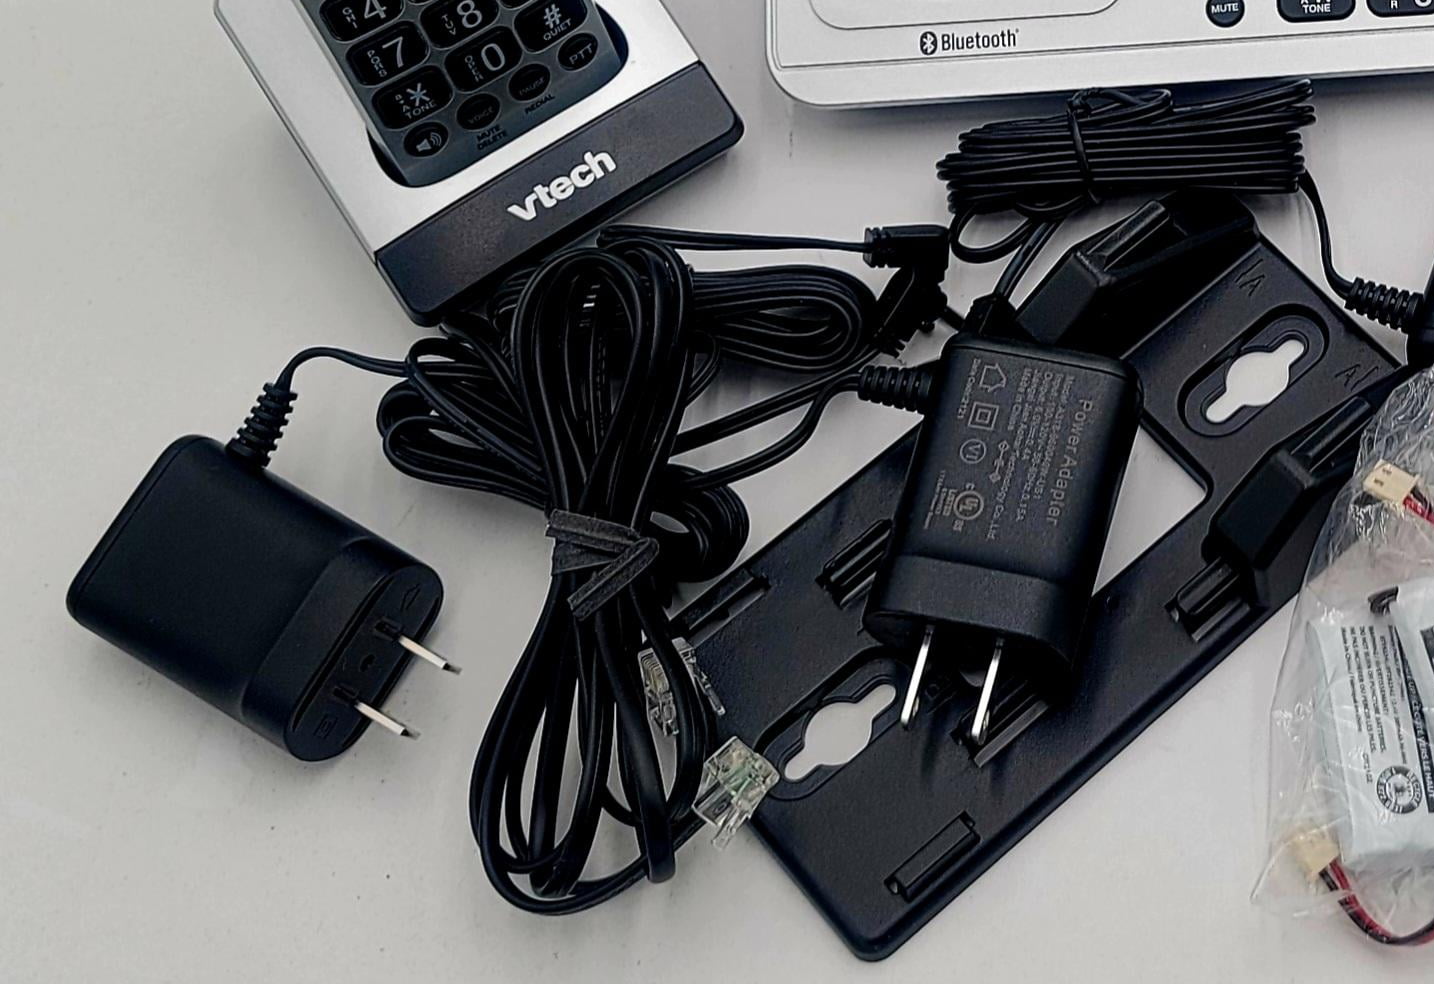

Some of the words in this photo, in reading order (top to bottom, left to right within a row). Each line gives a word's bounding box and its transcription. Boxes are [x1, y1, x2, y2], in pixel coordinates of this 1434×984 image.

[1210, 2, 1239, 14] MUTE
[1302, 3, 1331, 14] TONE
[941, 29, 1016, 51] Bluetooth
[507, 150, 617, 222] vtech
[1066, 398, 1093, 454] Power
[1046, 456, 1078, 526] Adapter
